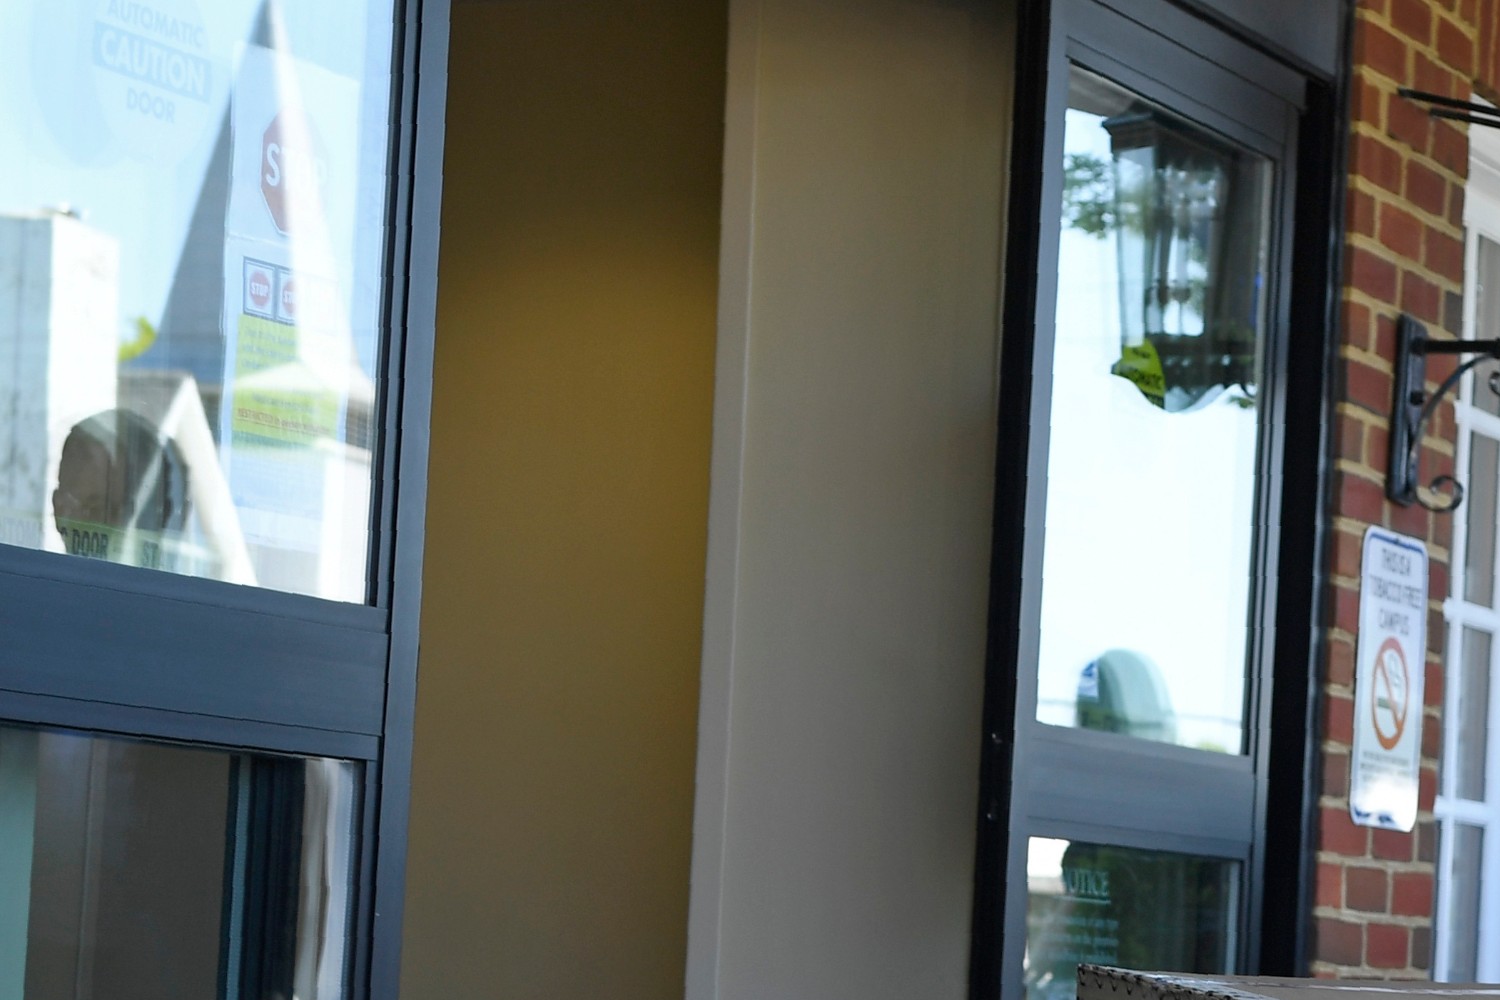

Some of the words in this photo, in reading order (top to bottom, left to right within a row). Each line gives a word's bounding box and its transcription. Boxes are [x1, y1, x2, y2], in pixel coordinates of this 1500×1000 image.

[107, 0, 204, 48] AUTOMATIC
[101, 29, 206, 97] CAUTION
[126, 87, 176, 125] DOOR
[71, 528, 110, 560] DOOR
